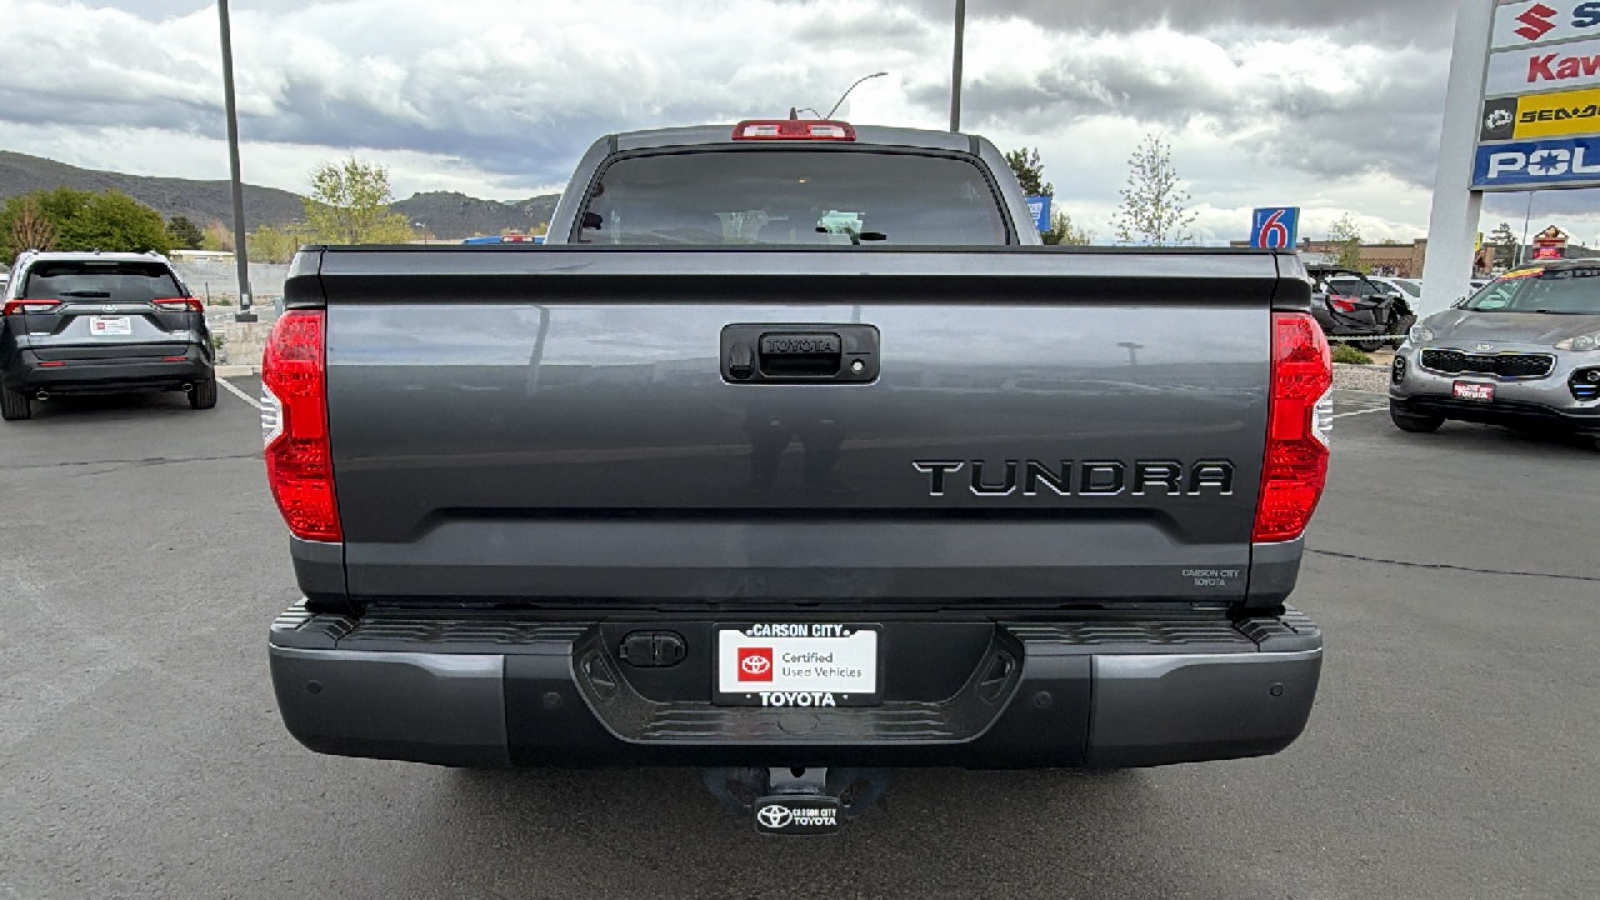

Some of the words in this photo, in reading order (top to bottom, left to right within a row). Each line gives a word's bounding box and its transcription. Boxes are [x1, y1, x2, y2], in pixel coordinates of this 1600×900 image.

[1487, 147, 1600, 178] POL
[1259, 210, 1288, 248] 6
[766, 339, 834, 353] TOYOTA
[911, 459, 1237, 496] TUNDRA
[1182, 569, 1219, 577] CARSON
[1220, 569, 1240, 578] CITY
[1194, 578, 1226, 586] TOYOTA
[752, 624, 808, 637] CARSON
[812, 624, 844, 637] CITY
[782, 652, 834, 663] Certified
[782, 667, 812, 677] Used
[815, 667, 862, 678] Vehicles
[759, 692, 836, 706] TOYOTA
[794, 817, 837, 825] TOYOTA
